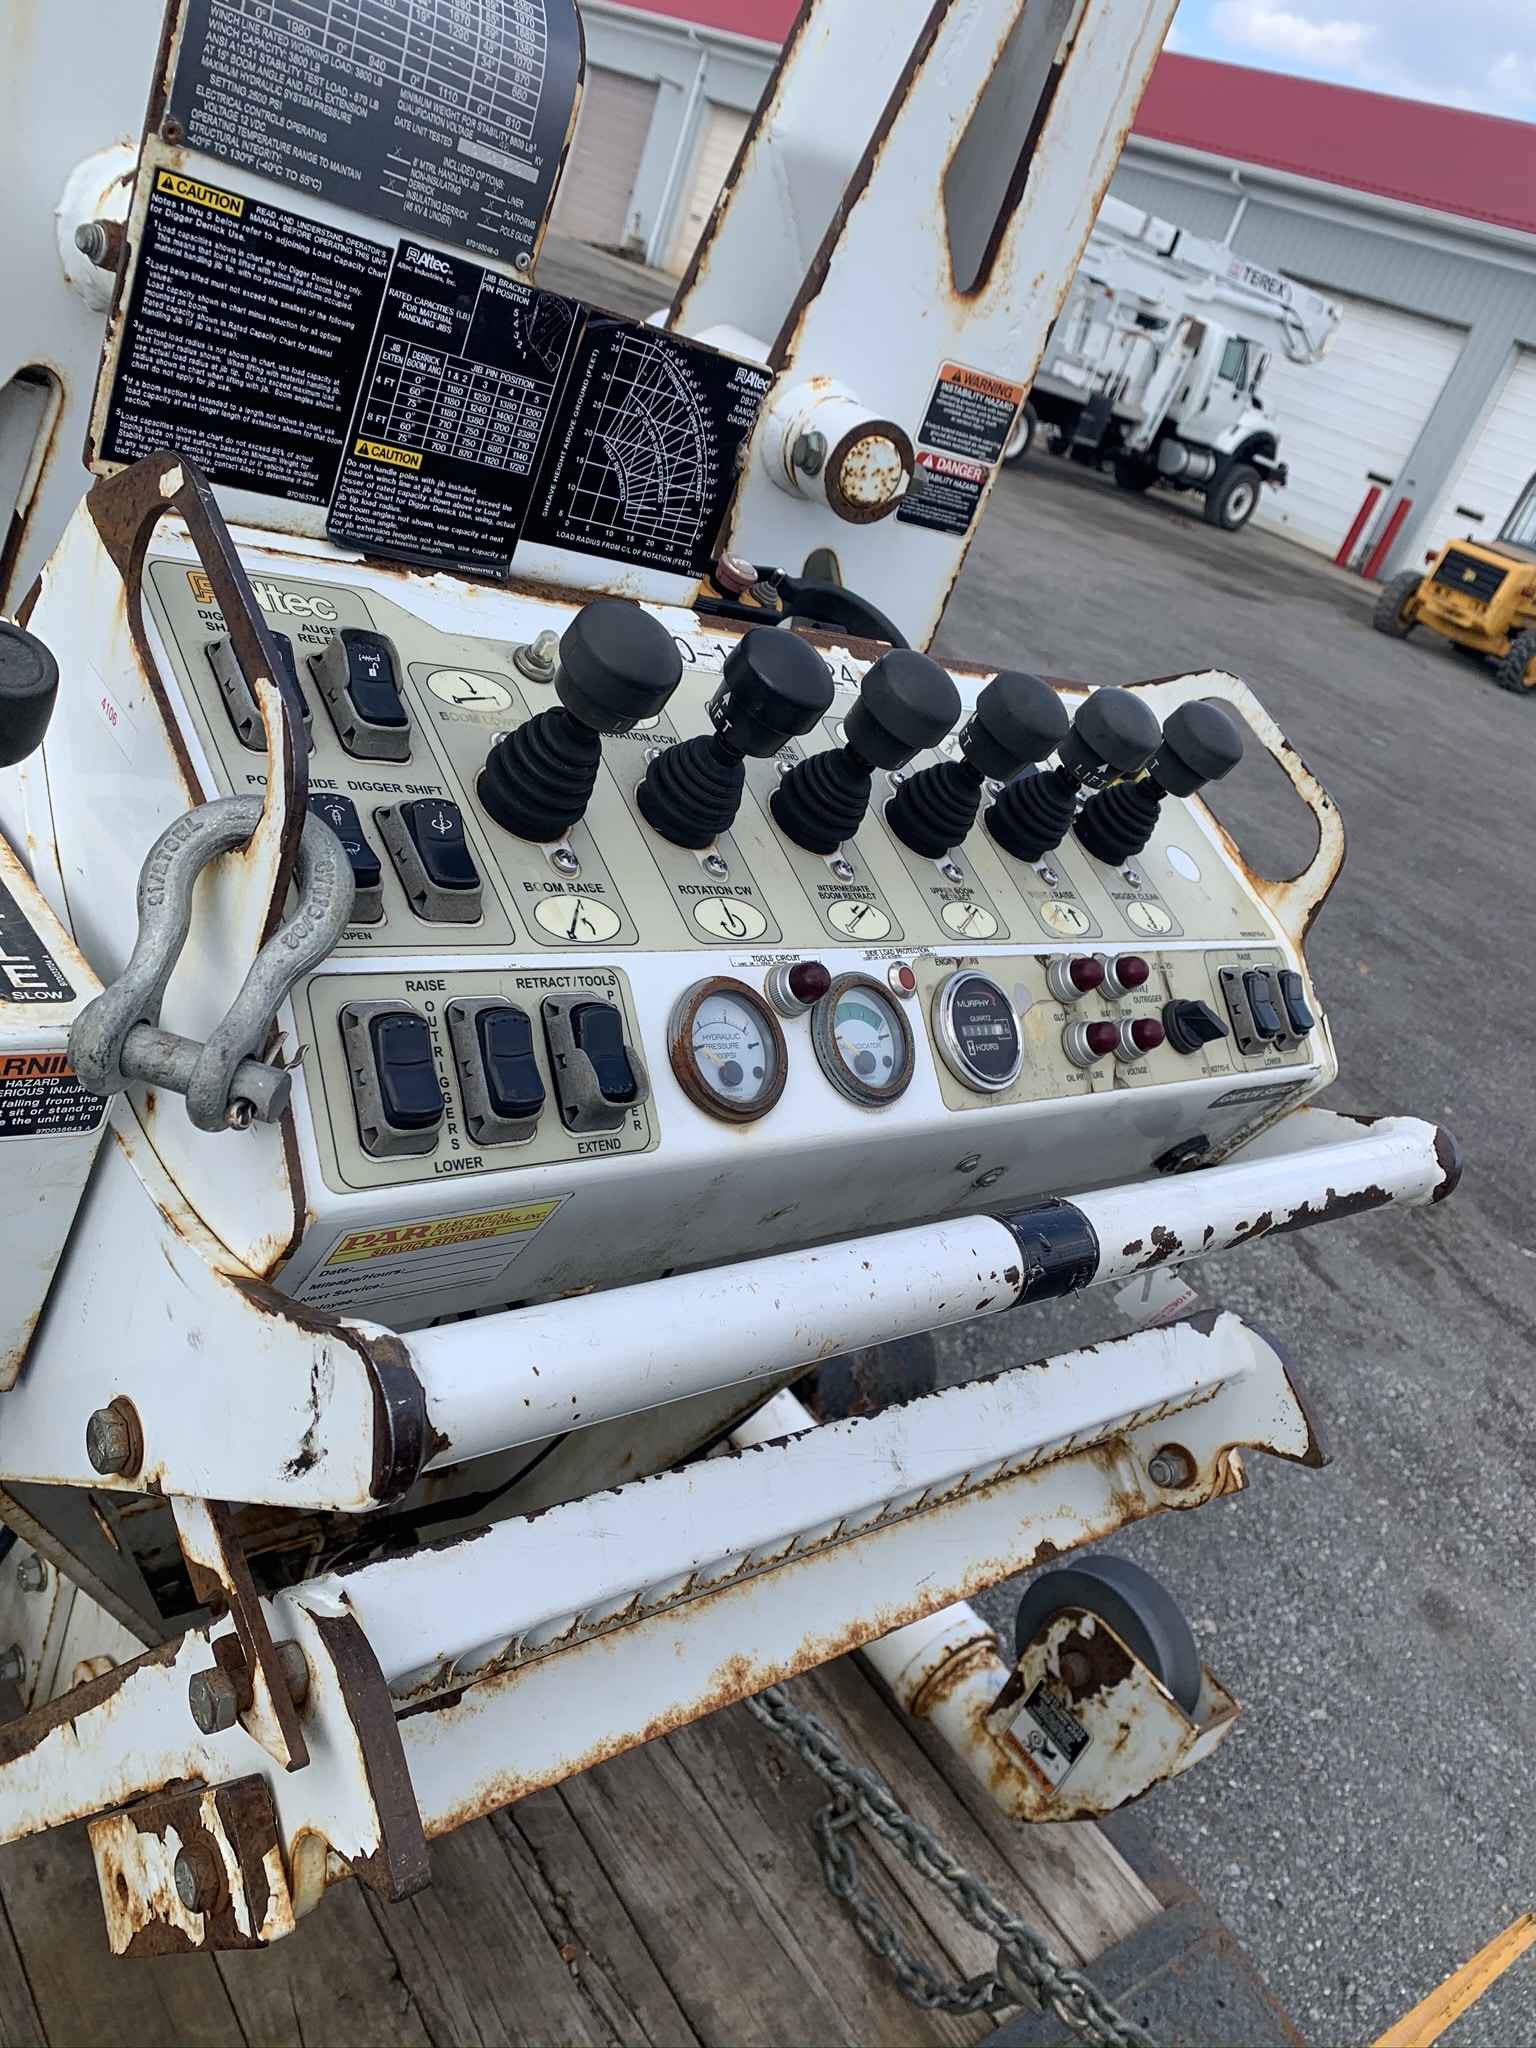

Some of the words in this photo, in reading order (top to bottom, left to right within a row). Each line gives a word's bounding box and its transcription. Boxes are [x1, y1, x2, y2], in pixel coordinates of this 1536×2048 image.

[206, 18, 241, 39] WINCH
[240, 32, 288, 59] CAPACITY:
[286, 51, 309, 67] 3800
[308, 60, 322, 72] LB
[366, 56, 387, 72] 940
[436, 86, 459, 103] 1110
[503, 116, 522, 130] 610
[175, 182, 241, 213] CAUTION
[148, 203, 162, 216] for
[163, 208, 193, 226] Digger
[194, 218, 226, 236] Derrick
[226, 229, 246, 243] Use.
[150, 193, 177, 210] Notes
[178, 202, 184, 212] 1
[185, 204, 204, 219] thru
[205, 211, 213, 222] 5
[213, 214, 240, 231] below
[241, 223, 262, 238] refer
[263, 230, 273, 242] to
[274, 234, 311, 254] adjoining
[311, 246, 332, 261] Load
[332, 253, 366, 272] Capacity
[366, 264, 387, 280] Chart
[255, 206, 277, 220] READ
[278, 214, 294, 226] AND
[295, 220, 344, 243] UNDERSTAND
[344, 237, 387, 258] OPERATOR'S
[417, 251, 450, 274] Altec
[482, 272, 497, 285] JIB
[497, 277, 532, 296] BRACKET
[1243, 265, 1287, 297] TEREX
[480, 282, 494, 294] PIN
[495, 287, 530, 305] POSITION
[387, 288, 412, 304] RATED
[413, 296, 455, 316] CAPACITIES
[455, 308, 472, 321] (LB)
[401, 302, 417, 314] FOR
[418, 307, 453, 324] MATERIAL
[397, 310, 435, 328] HANDLING
[435, 322, 452, 334] JIBS
[470, 363, 483, 374] JIB
[484, 367, 498, 378] PIN
[499, 371, 535, 389] POSITION
[964, 372, 1013, 398] WARNING
[941, 382, 986, 403] INSTABILITY
[986, 396, 1014, 411] HAZARD
[733, 405, 755, 418] RANGE
[542, 483, 557, 517] SHEAVE
[553, 452, 567, 483] HEIGHT
[564, 420, 577, 451] ABOVE
[573, 379, 589, 418] GROUND
[586, 349, 600, 378] (FEET)
[370, 446, 419, 466] CAUTION
[937, 459, 982, 480] DANGER
[955, 480, 979, 492] HAZARD
[555, 530, 575, 541] LOAD
[575, 535, 600, 547] RADIUS
[601, 541, 620, 551] FROM
[632, 548, 641, 556] OF
[641, 550, 672, 563] ROTATION
[672, 557, 691, 568] (FEET)
[302, 623, 337, 635] AUGE
[101, 697, 117, 726] 4106
[439, 711, 481, 725] BOOM
[481, 715, 524, 729] LOWE
[653, 734, 677, 745] CCW
[1074, 764, 1109, 789] LIFT
[347, 781, 403, 793] DIGGER
[405, 784, 442, 795] SHIFT
[523, 882, 563, 893] BOOM
[566, 883, 606, 894] RAISE
[678, 884, 734, 896] ROTATION
[734, 886, 752, 896] CW
[817, 884, 871, 893] INTERMEDIATE
[840, 892, 876, 900] RETRACT
[1111, 892, 1136, 900] DIGGER
[1137, 893, 1160, 901] CLEAN
[342, 932, 372, 941] OPEN
[895, 947, 929, 955] PROTECTION
[405, 979, 446, 992] RAISE
[516, 977, 572, 989] RETRACT
[579, 975, 616, 987] TOOLS
[12, 991, 63, 1000] SLOW
[1133, 994, 1162, 1004] OUTRIGGER
[957, 1000, 989, 1008] MURPHY
[702, 1033, 741, 1041] HYDRAULIC
[976, 1044, 999, 1052] HOURS
[1264, 1057, 1282, 1065] LOWER
[424, 1001, 460, 1150] OUTRIGGERS
[1066, 1074, 1076, 1082] OIL
[1127, 1066, 1148, 1075] VOLTAGE
[5, 1079, 60, 1088] HAZARD
[0, 1088, 44, 1097] ERIOUS
[50, 1087, 86, 1096] INJUR
[1, 1099, 40, 1108] falling
[45, 1097, 74, 1105] from
[80, 1096, 98, 1104] the
[9, 1108, 24, 1116] sit
[48, 1105, 84, 1114] stand
[11, 1117, 33, 1125] the
[37, 1115, 61, 1123] unit
[577, 1138, 621, 1154] EXTEND
[434, 1157, 483, 1173] LOWER
[435, 1212, 512, 1230] ELECTRICAL
[524, 1211, 547, 1221] INC.
[340, 1225, 431, 1252] PAR
[370, 1239, 430, 1258] SERVICE
[432, 1228, 498, 1248] STICKERS
[308, 1268, 406, 1290] Mileage/Hours:
[318, 1266, 354, 1277] Date:
[300, 1292, 330, 1303] Next
[332, 1283, 385, 1298] Service:
